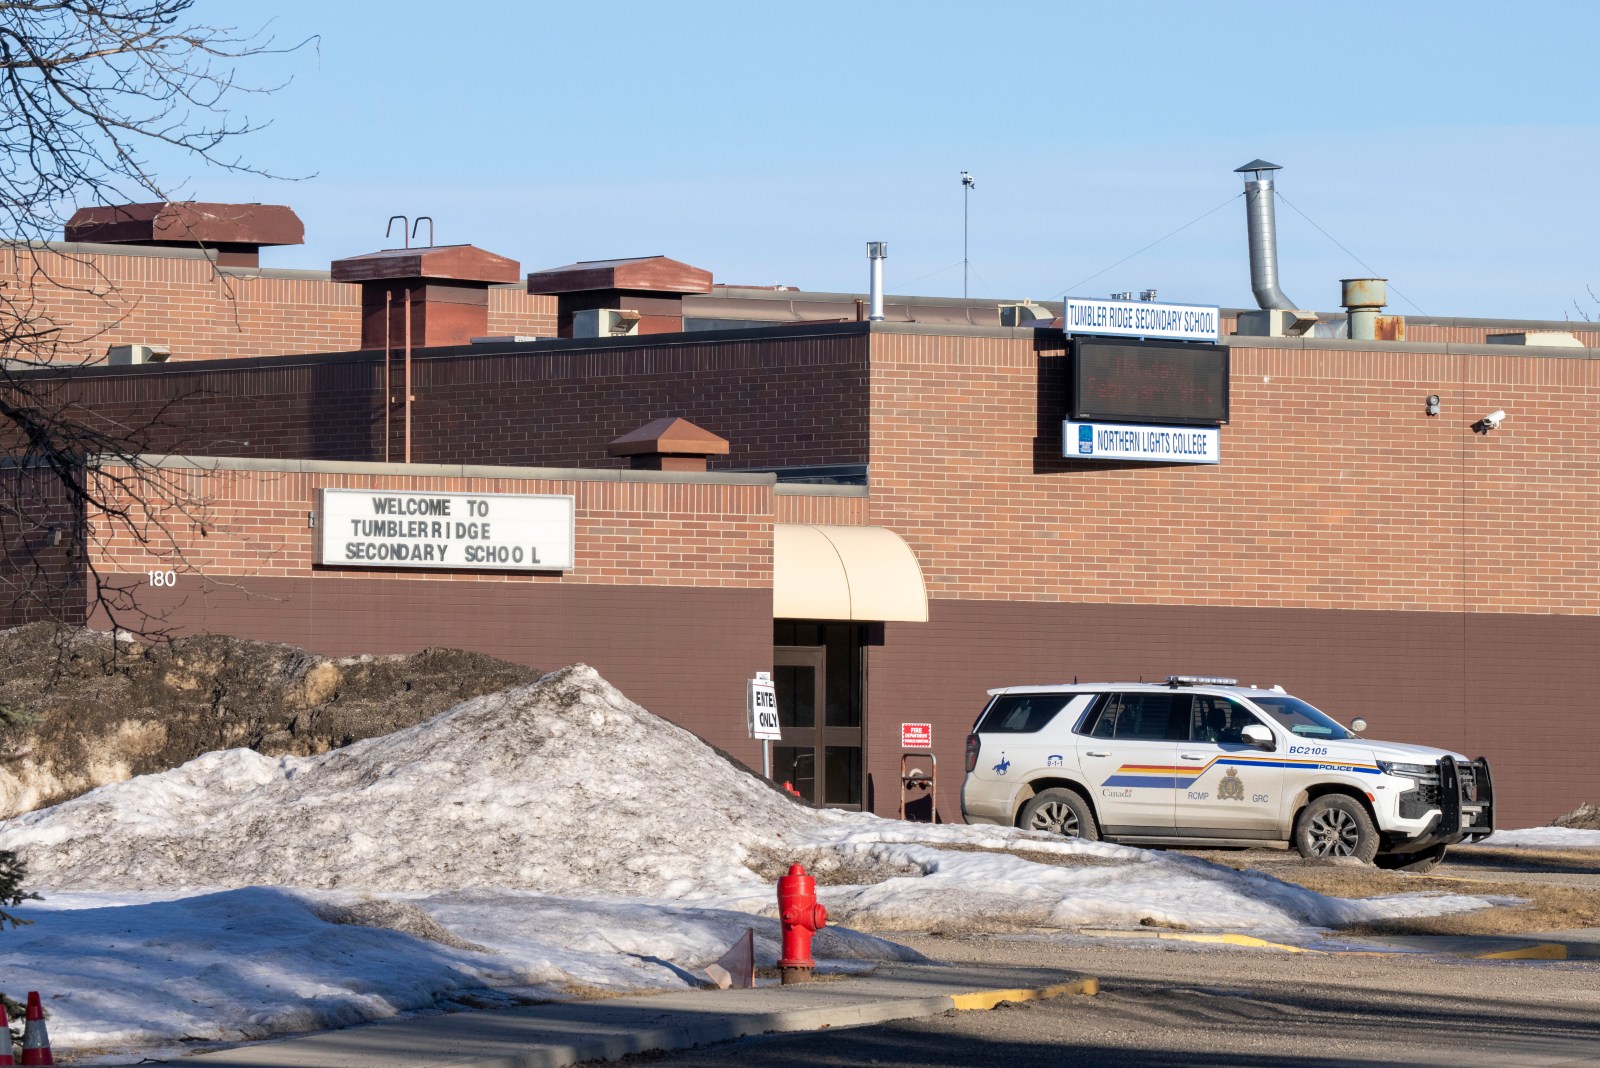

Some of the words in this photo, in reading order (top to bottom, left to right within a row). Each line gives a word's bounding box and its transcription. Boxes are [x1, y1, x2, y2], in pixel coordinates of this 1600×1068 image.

[1069, 304, 1107, 327] TUMBLER
[1109, 306, 1133, 329] RIDGE
[1135, 308, 1182, 331] SECONDARY
[1184, 310, 1215, 333] SCHOOL
[1097, 430, 1140, 452] NORTHERN
[1142, 432, 1170, 453] LIGHTS
[1172, 433, 1207, 455] COLLEGE
[372, 497, 451, 516] WELCOME
[467, 499, 489, 517] TO
[345, 541, 448, 561] SECONDARY
[464, 544, 541, 563] SCHOOL
[148, 570, 176, 587] 180
[759, 712, 777, 728] ONLY
[1289, 746, 1328, 755] BC2105
[1319, 764, 1353, 772] POLICE
[1102, 788, 1132, 798] Canada
[1187, 791, 1209, 800] RCMP
[1252, 794, 1269, 803] GRC
